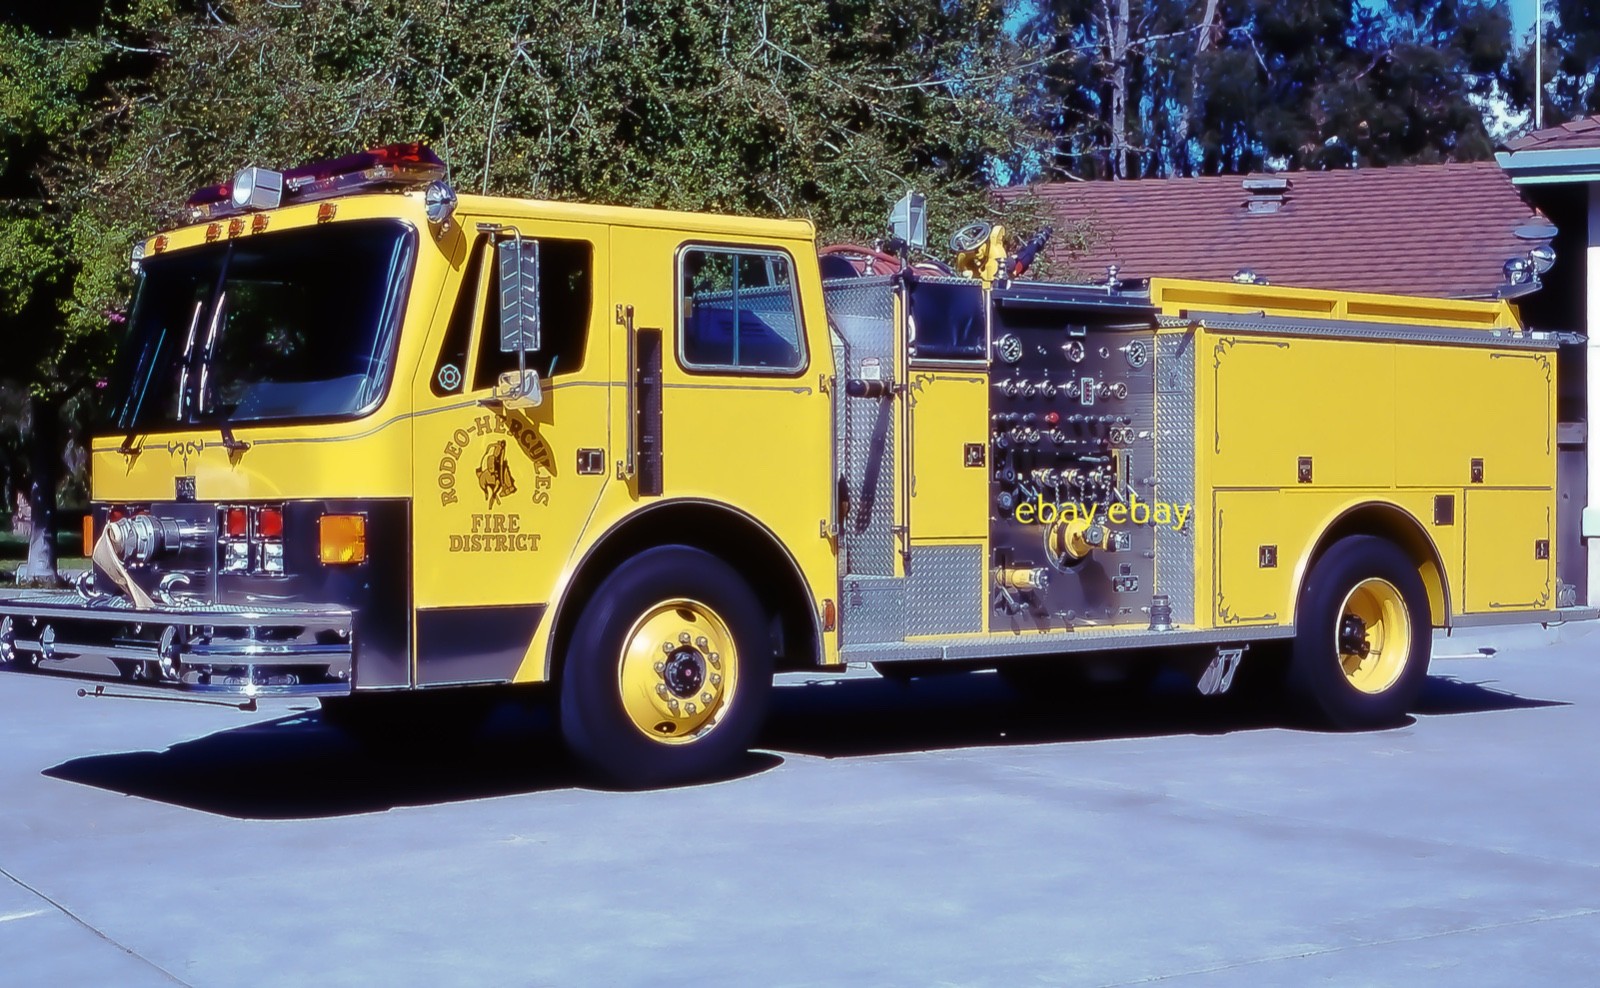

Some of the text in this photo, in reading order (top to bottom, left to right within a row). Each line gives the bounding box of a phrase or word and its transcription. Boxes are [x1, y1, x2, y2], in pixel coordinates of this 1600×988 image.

[439, 415, 551, 506] RODEO-HERCULES
[471, 514, 520, 533] FIRE
[450, 534, 541, 552] DISTRICT
